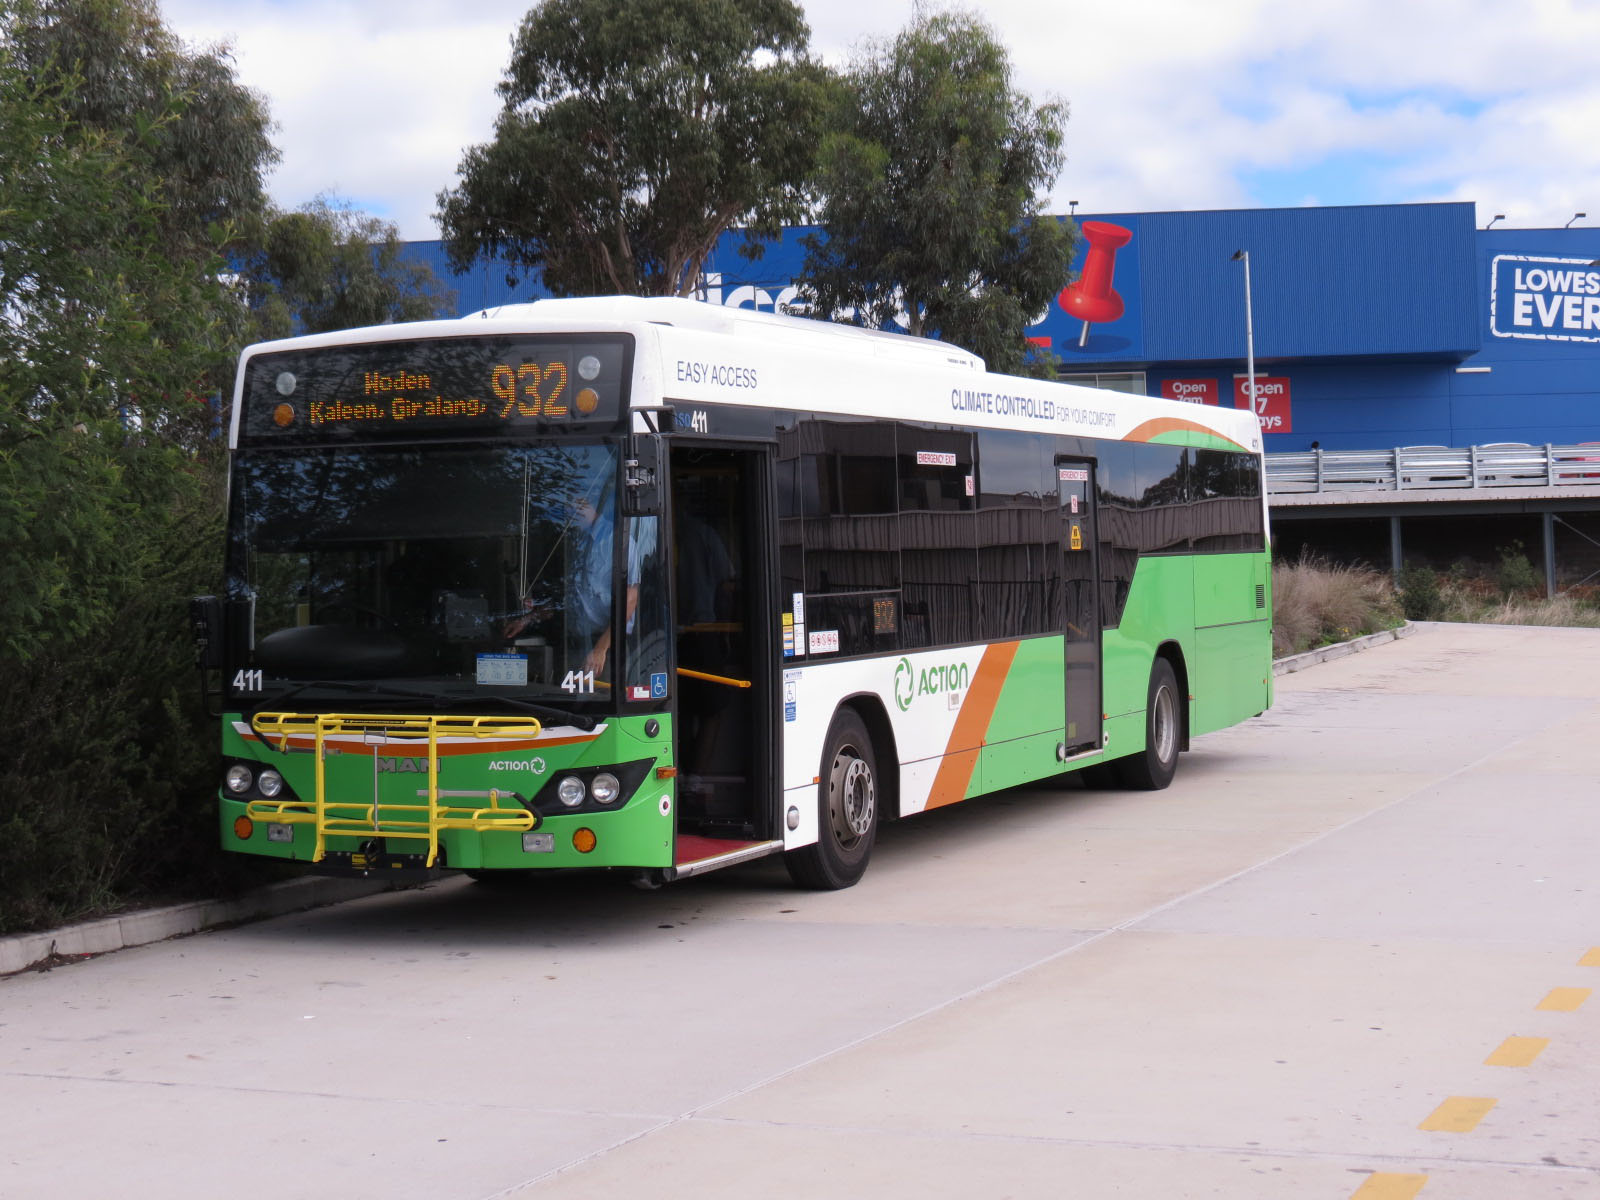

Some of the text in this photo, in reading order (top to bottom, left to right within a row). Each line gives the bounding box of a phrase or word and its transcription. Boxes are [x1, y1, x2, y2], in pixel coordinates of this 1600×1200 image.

[1514, 292, 1600, 330] EVER
[364, 370, 431, 395] Woden
[677, 360, 758, 389] EASY ACCESS
[491, 361, 568, 418] 932
[1172, 382, 1207, 395] Open
[1241, 381, 1284, 397] Open
[951, 389, 1116, 428] CLIMATE CONTROLLED FOR YOUR COMFORT
[1257, 397, 1268, 414] 7
[691, 409, 708, 434] 411
[1259, 415, 1283, 430] ays
[918, 453, 944, 464] EMERGENCY
[232, 669, 263, 692] 411
[560, 670, 594, 694] 411
[918, 662, 969, 697] ACTION
[376, 757, 442, 774] MAN
[488, 760, 530, 771] ACTION
